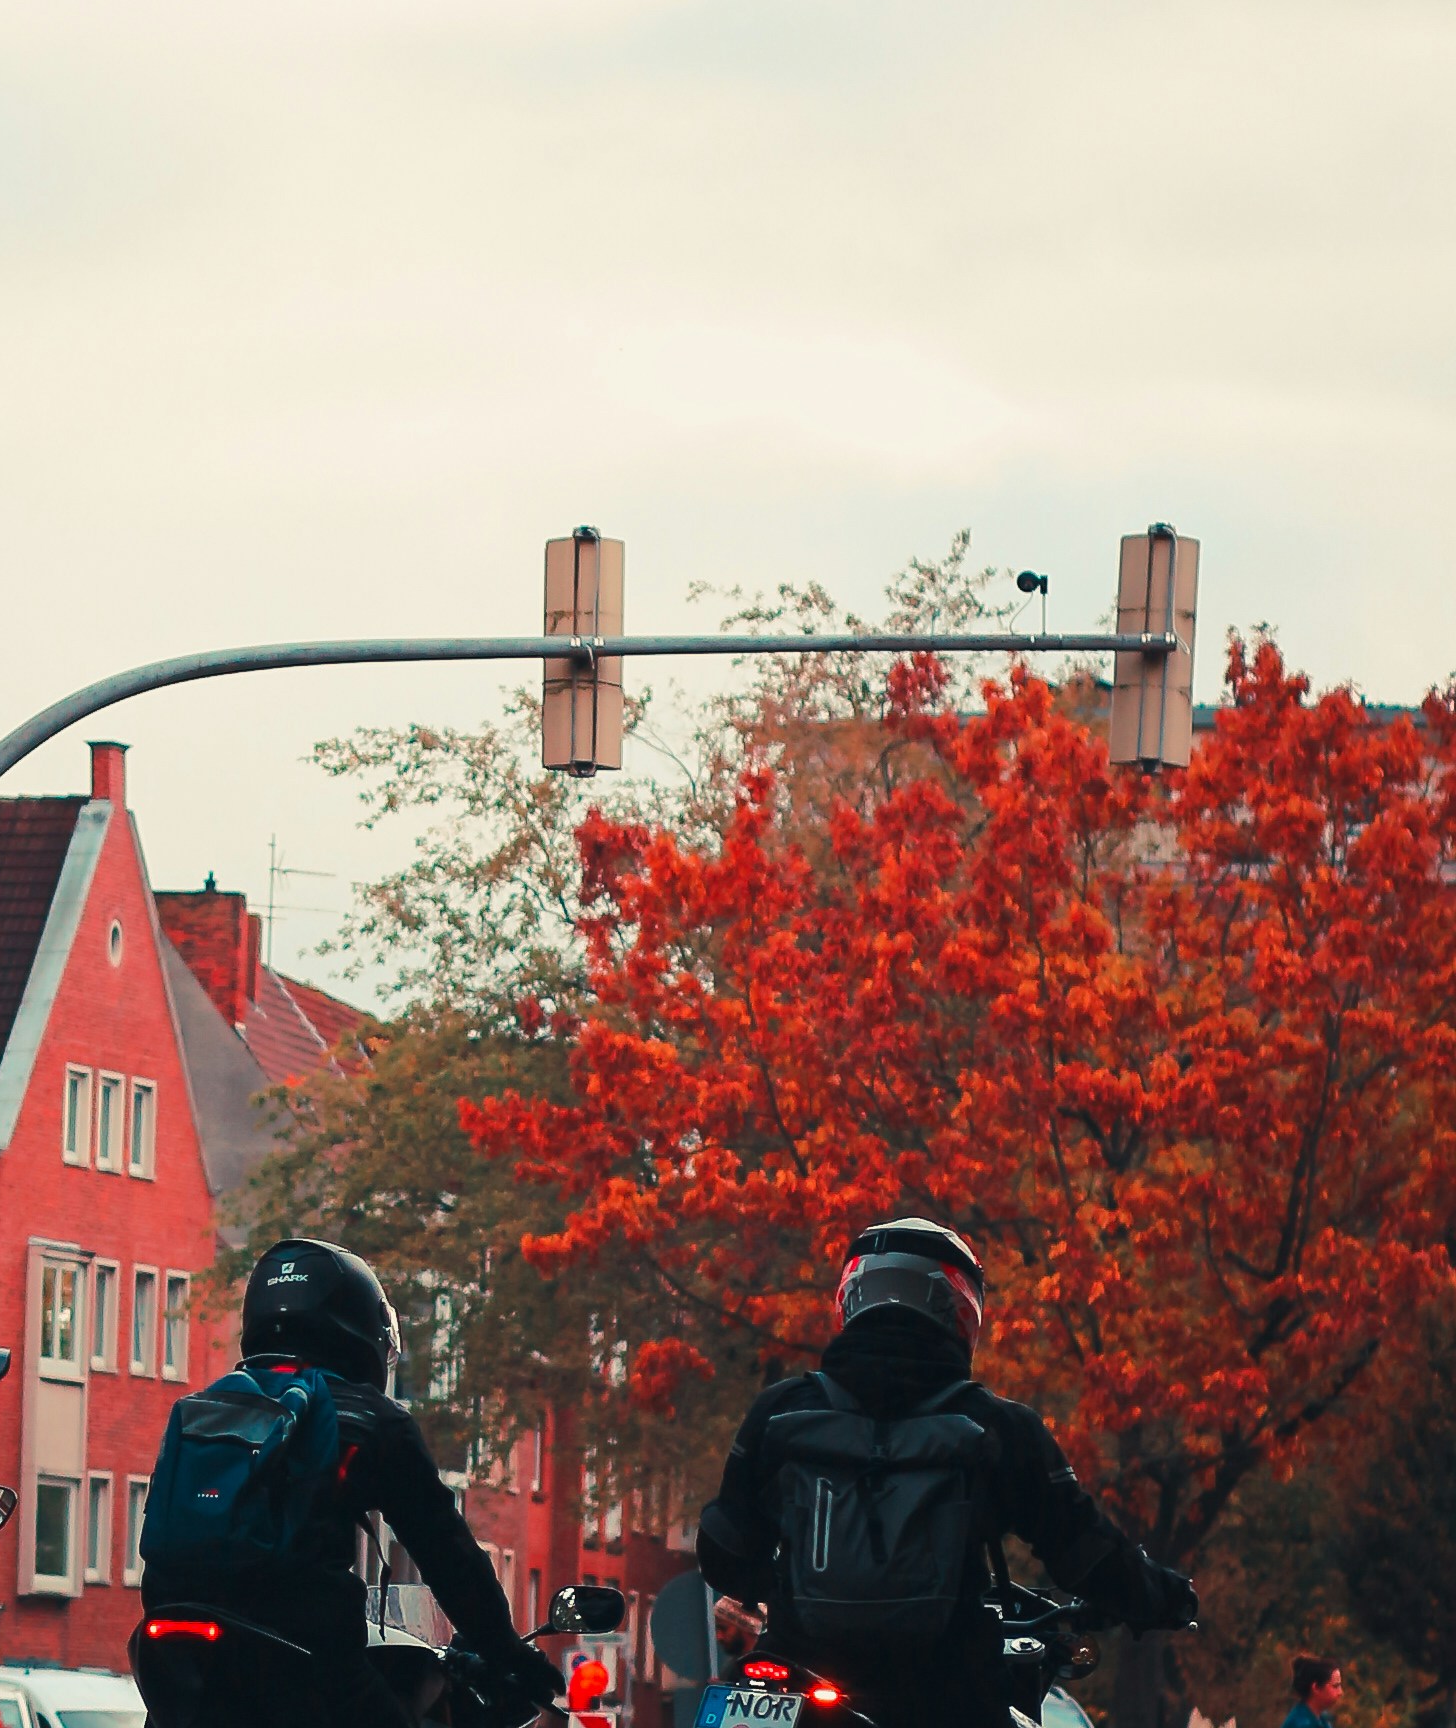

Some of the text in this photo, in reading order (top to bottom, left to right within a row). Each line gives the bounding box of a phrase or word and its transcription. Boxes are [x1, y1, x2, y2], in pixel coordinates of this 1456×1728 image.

[267, 1274, 308, 1286] SHARK
[729, 1693, 796, 1722] NOR
[705, 1713, 716, 1724] D
